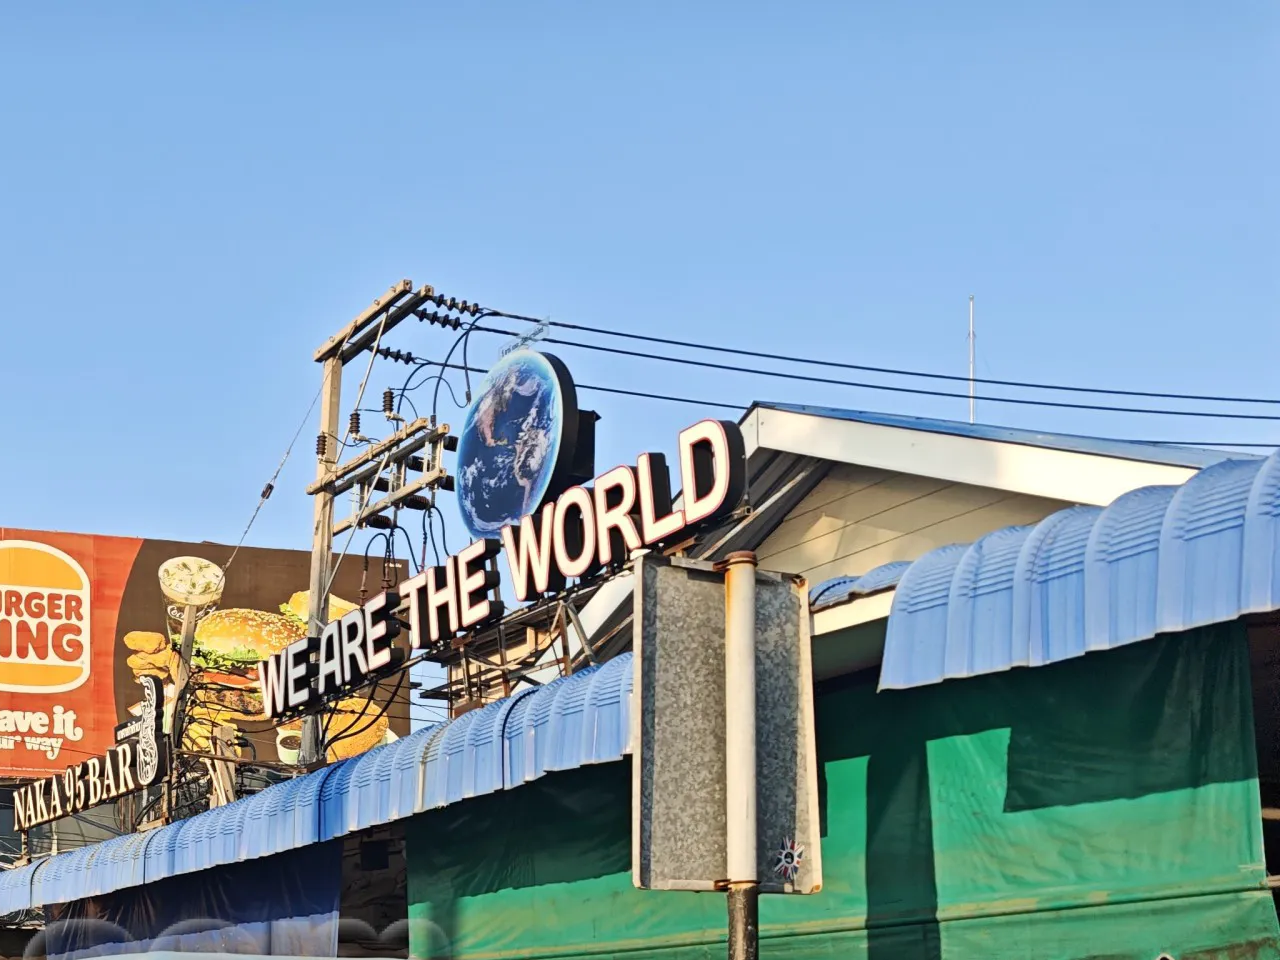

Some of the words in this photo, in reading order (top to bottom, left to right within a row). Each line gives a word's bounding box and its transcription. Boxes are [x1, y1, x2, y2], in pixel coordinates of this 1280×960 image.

[258, 638, 309, 718] WE
[318, 592, 391, 695] ARE
[399, 538, 490, 649] THE
[501, 418, 730, 601] WORLD
[24, 735, 63, 760] way
[52, 705, 84, 741] it
[13, 774, 63, 831] NAKA
[64, 765, 85, 811] 95
[87, 743, 135, 805] BAR
